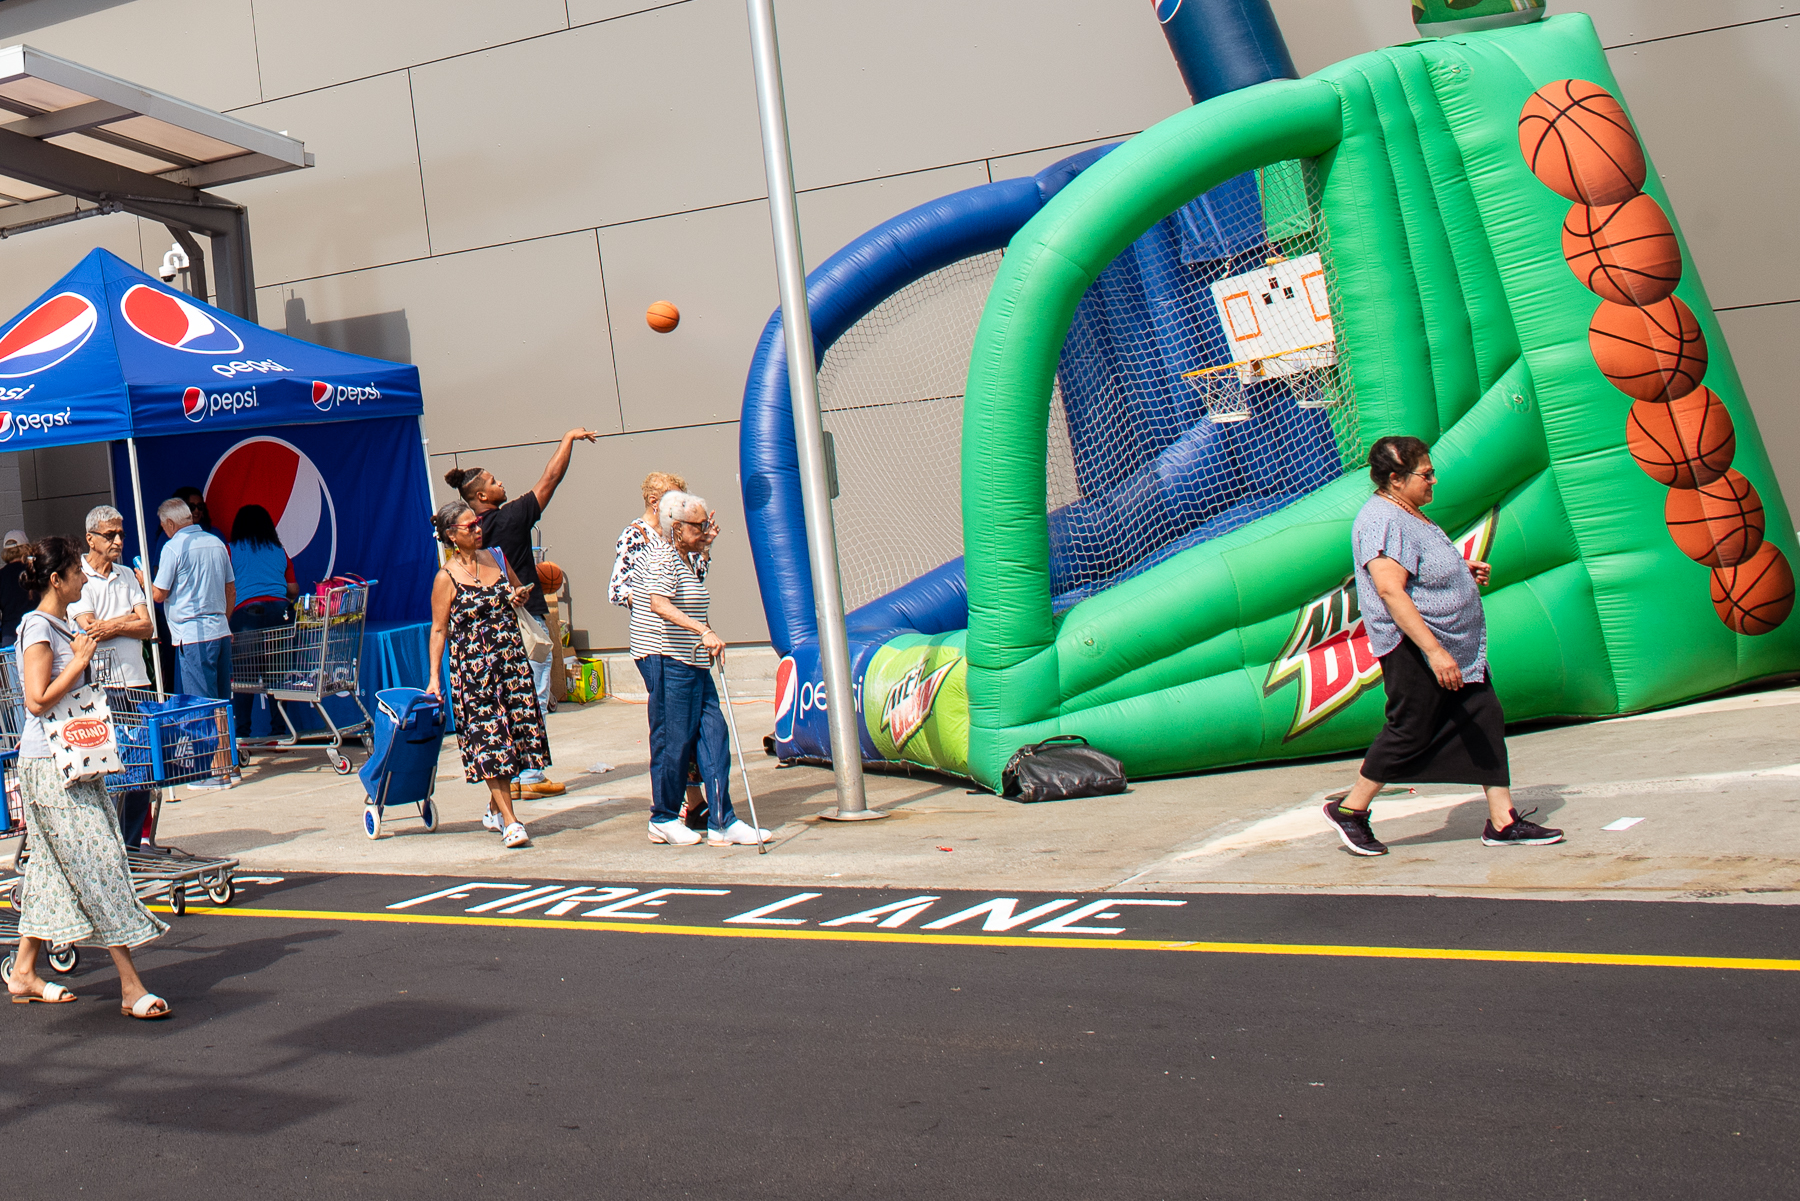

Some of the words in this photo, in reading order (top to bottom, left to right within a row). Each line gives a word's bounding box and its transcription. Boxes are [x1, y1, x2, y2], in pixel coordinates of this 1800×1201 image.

[212, 359, 293, 378] pepsi
[210, 386, 258, 416] pepsi
[337, 382, 381, 406] pepsi
[16, 407, 71, 435] pepsi
[65, 724, 106, 741] STRAND
[386, 882, 731, 919] FIRE
[722, 892, 1187, 934] LANE
